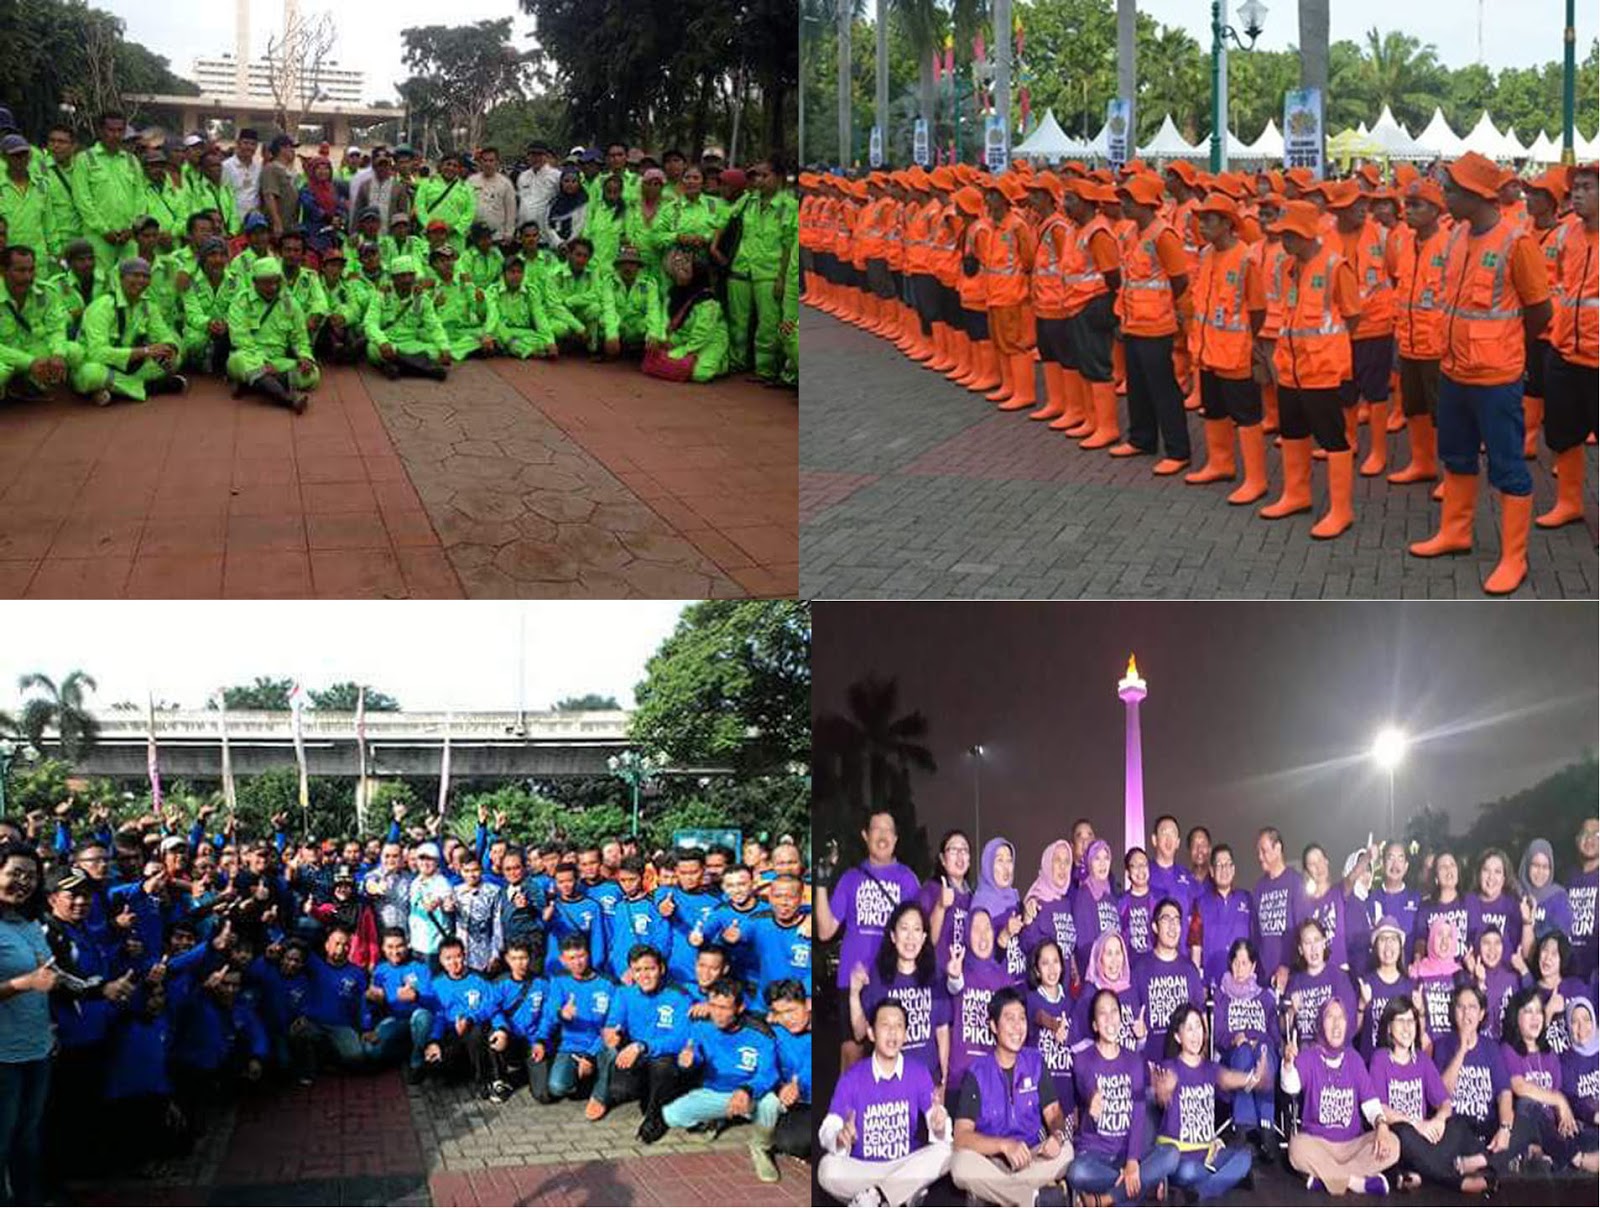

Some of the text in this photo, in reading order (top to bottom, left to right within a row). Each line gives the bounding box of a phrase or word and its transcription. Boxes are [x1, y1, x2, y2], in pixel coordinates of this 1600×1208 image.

[857, 909, 890, 926] PIKU
[1148, 976, 1188, 989] JANGAN
[963, 988, 992, 1001] JANG
[1149, 986, 1188, 1000] MAKLUM
[901, 998, 932, 1011] KLUM
[908, 1010, 931, 1025] GAN
[1150, 1012, 1171, 1028] PIK
[963, 1026, 997, 1045] PIKU
[1457, 1077, 1492, 1091] AKLUM
[863, 1100, 909, 1118] JANGAN
[864, 1114, 910, 1131] MAKLUM
[1098, 1113, 1131, 1130] IKUN
[864, 1128, 910, 1145] DENGAN
[863, 1140, 910, 1158] PIKUN
